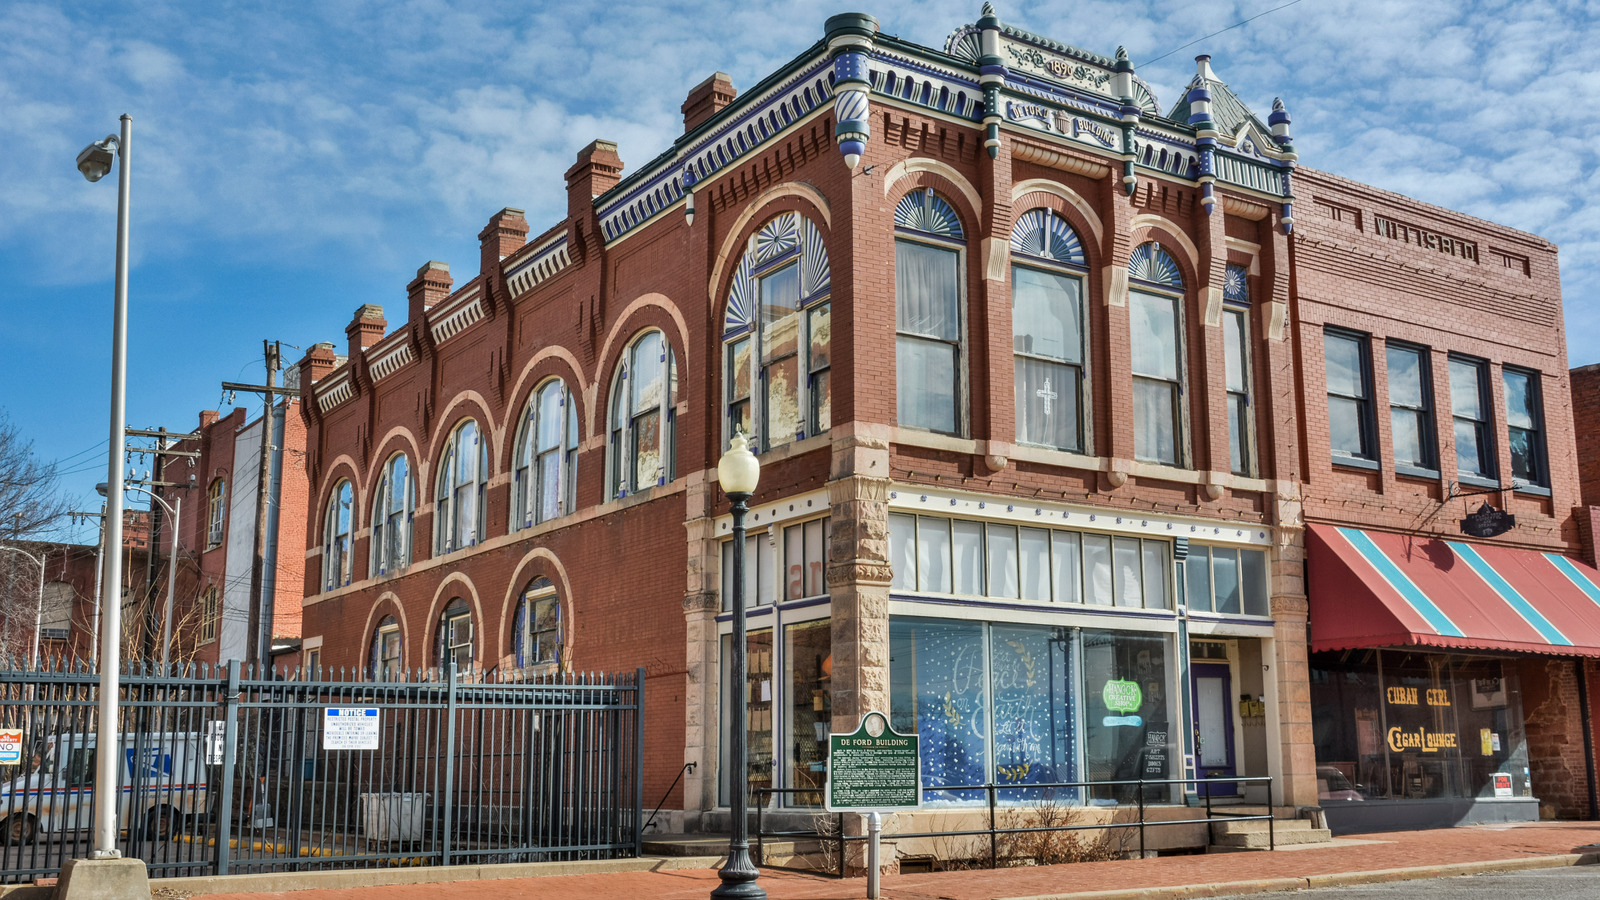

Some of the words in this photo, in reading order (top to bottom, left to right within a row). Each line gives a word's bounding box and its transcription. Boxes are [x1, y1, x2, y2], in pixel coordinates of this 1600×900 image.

[1050, 60, 1073, 75] 1890
[1012, 106, 1024, 118] DE
[1024, 104, 1049, 119] FORD
[1077, 119, 1115, 145] BUILDING
[1387, 686, 1418, 705] CUBAN
[1426, 688, 1451, 706] GIRL
[339, 708, 366, 716] NOTICE
[840, 738, 851, 746] DE
[852, 738, 873, 746] FORD
[875, 738, 909, 746] BUILDING
